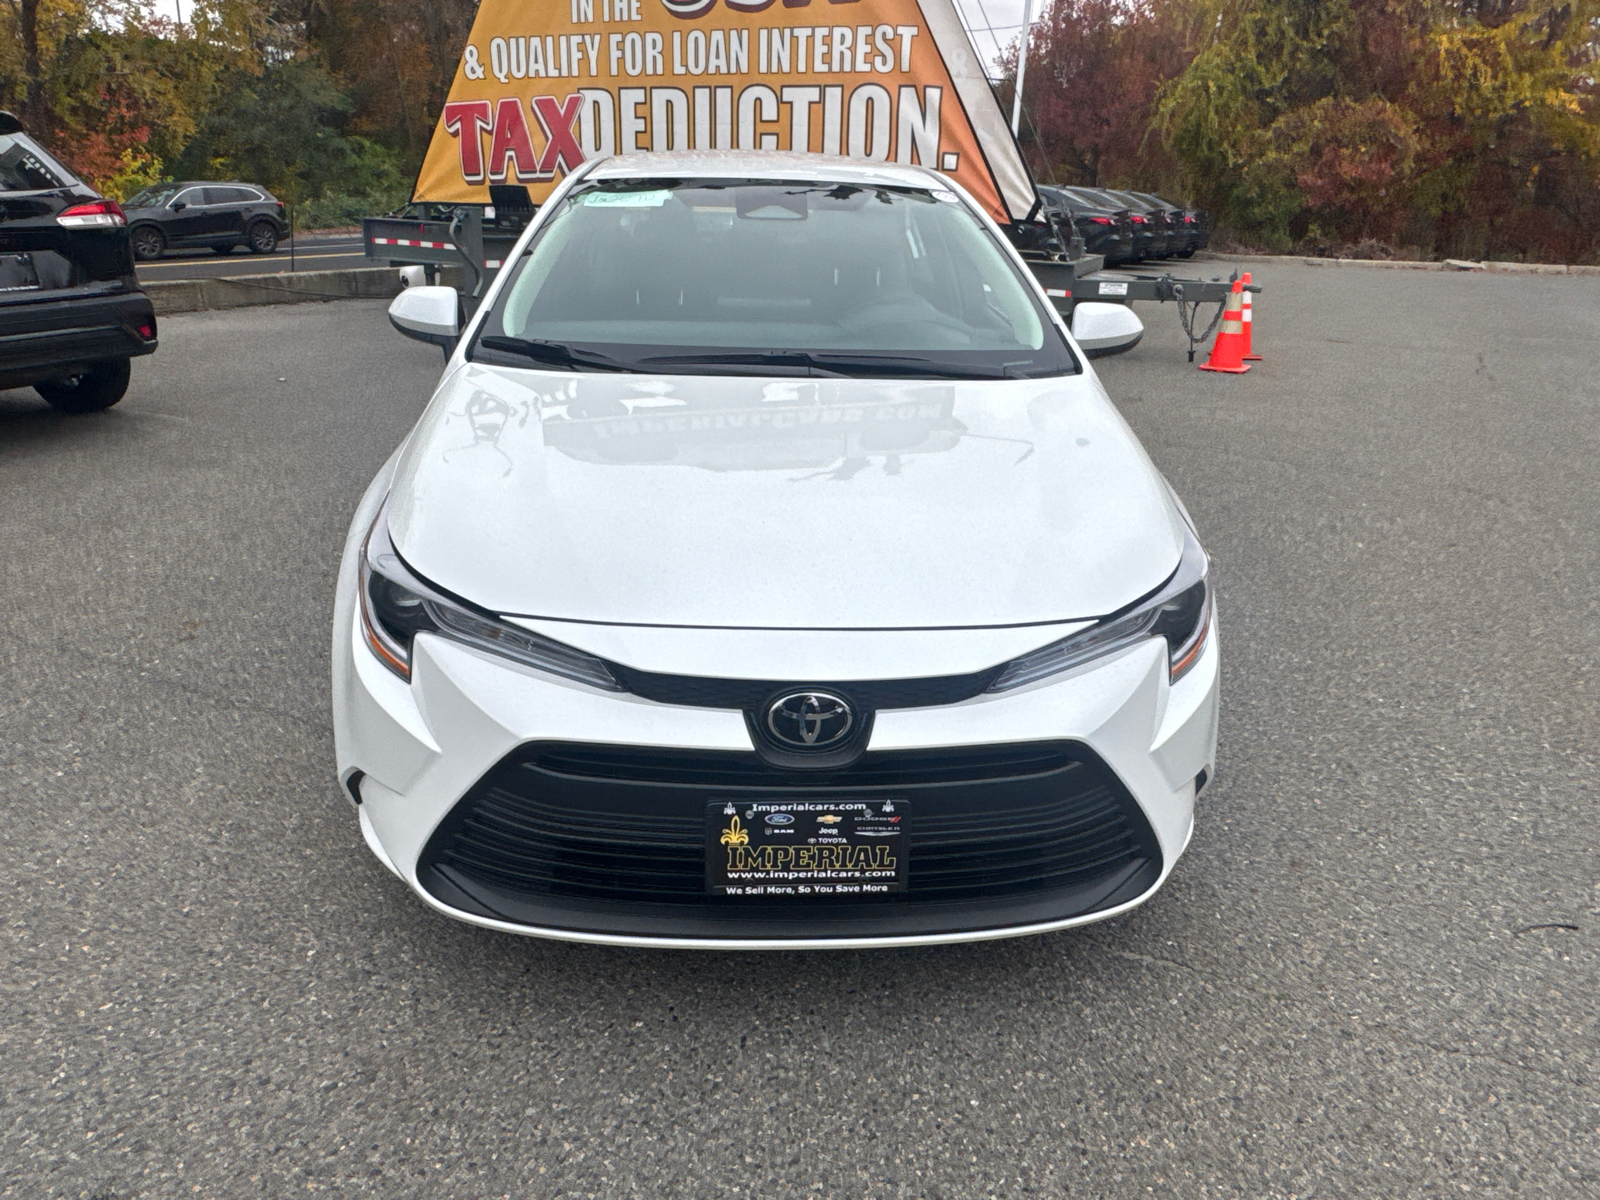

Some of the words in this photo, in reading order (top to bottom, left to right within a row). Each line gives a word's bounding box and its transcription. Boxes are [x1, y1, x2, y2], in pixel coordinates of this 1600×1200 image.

[570, 0, 595, 24] IN
[464, 44, 486, 80] &
[490, 34, 601, 84] QUALIFY
[609, 31, 664, 77] FOR
[672, 28, 749, 76] LOAN
[757, 24, 919, 74] INTEREST
[444, 92, 586, 186] TAX
[577, 86, 960, 172] DEDUCTION.
[752, 802, 867, 813] Imperialcars.com
[769, 814, 791, 824] Ford
[818, 827, 838, 836] Jeep
[727, 845, 897, 870] IMPERIAL
[727, 869, 896, 880] www.imperialcars.com
[726, 887, 743, 895] We
[745, 886, 764, 895] Sell
[767, 886, 795, 895] More,
[813, 885, 834, 893] You
[835, 885, 860, 893] Save
[862, 884, 888, 893] More
